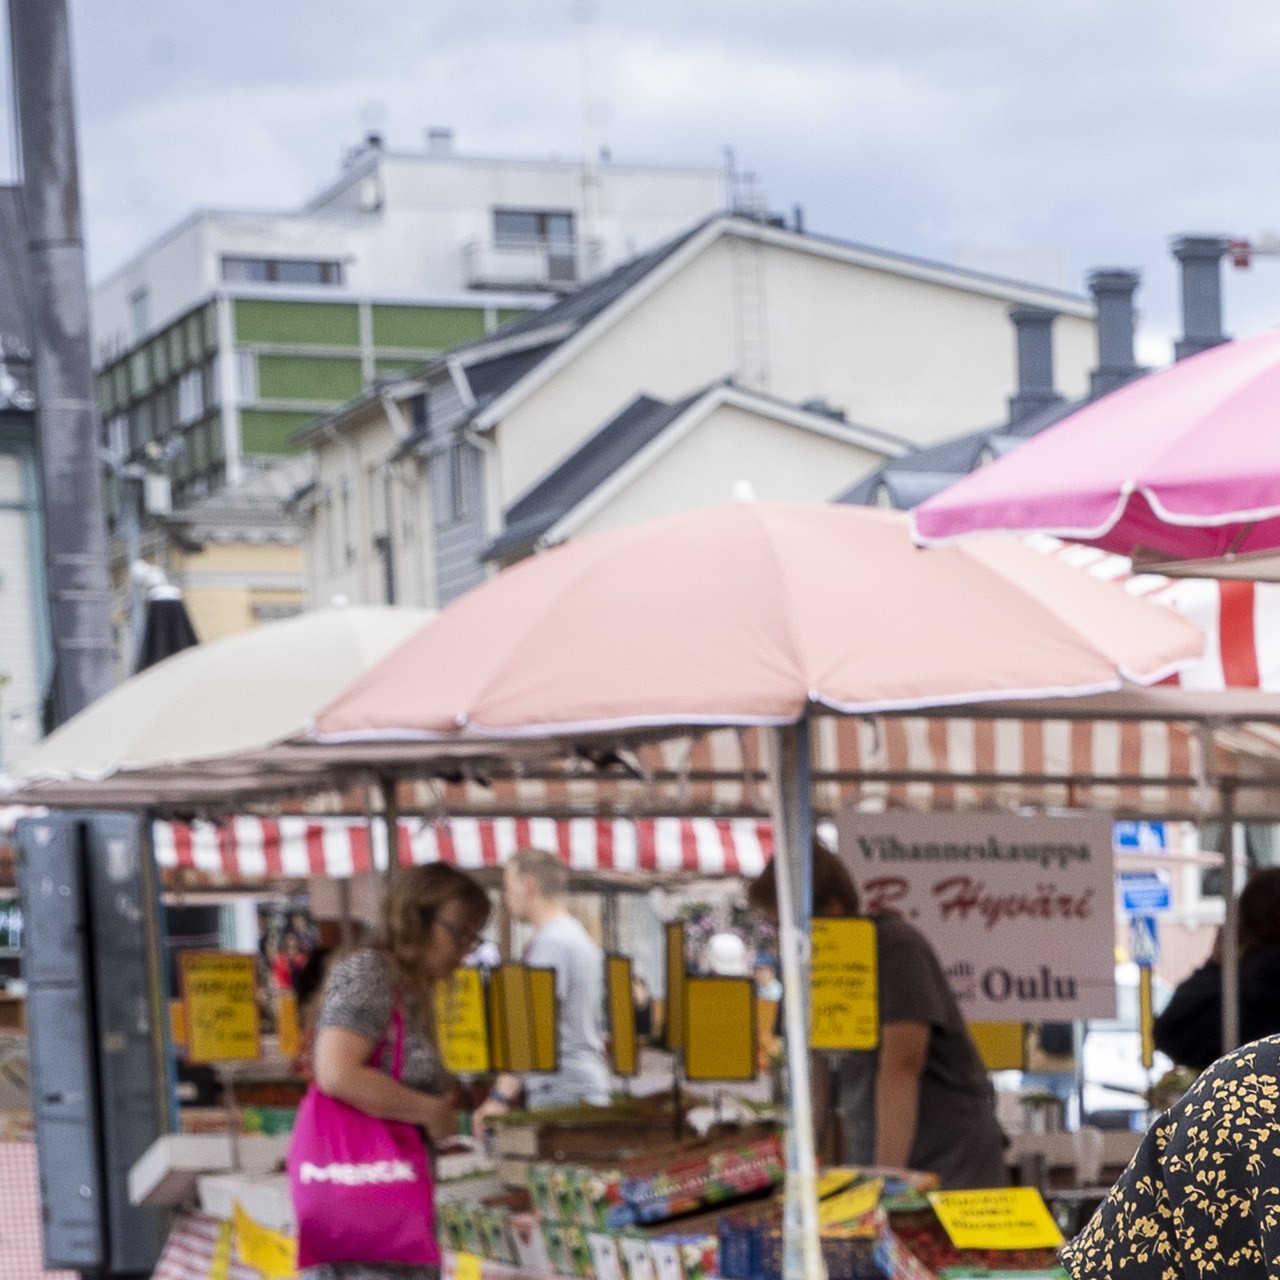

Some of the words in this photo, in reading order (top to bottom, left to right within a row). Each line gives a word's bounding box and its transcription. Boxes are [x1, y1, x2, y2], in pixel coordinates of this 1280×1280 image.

[857, 834, 1091, 870] Vihanneskauppa
[931, 874, 1096, 931] Hyväri
[981, 964, 1078, 1001] Oulu
